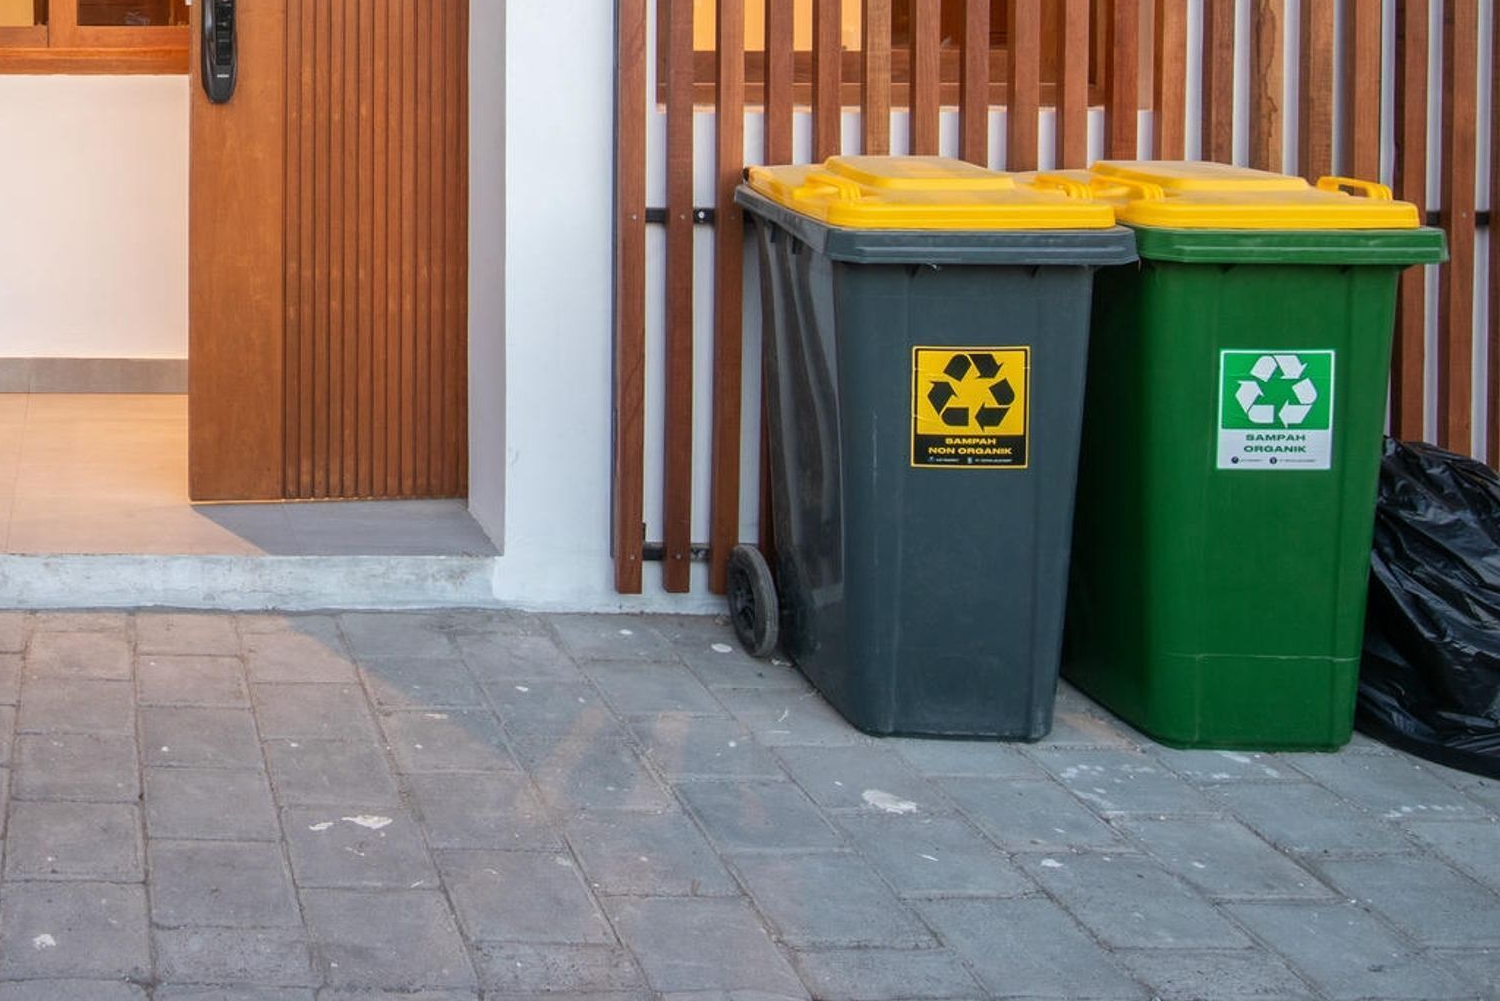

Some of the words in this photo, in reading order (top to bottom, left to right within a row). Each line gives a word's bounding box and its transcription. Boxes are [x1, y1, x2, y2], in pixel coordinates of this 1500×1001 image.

[945, 437, 997, 445] SAMPAH
[1246, 434, 1306, 442] SAMPAH
[928, 447, 955, 455] NON
[958, 447, 1013, 455] ORGANIK
[1243, 445, 1307, 453] ORGANIK
